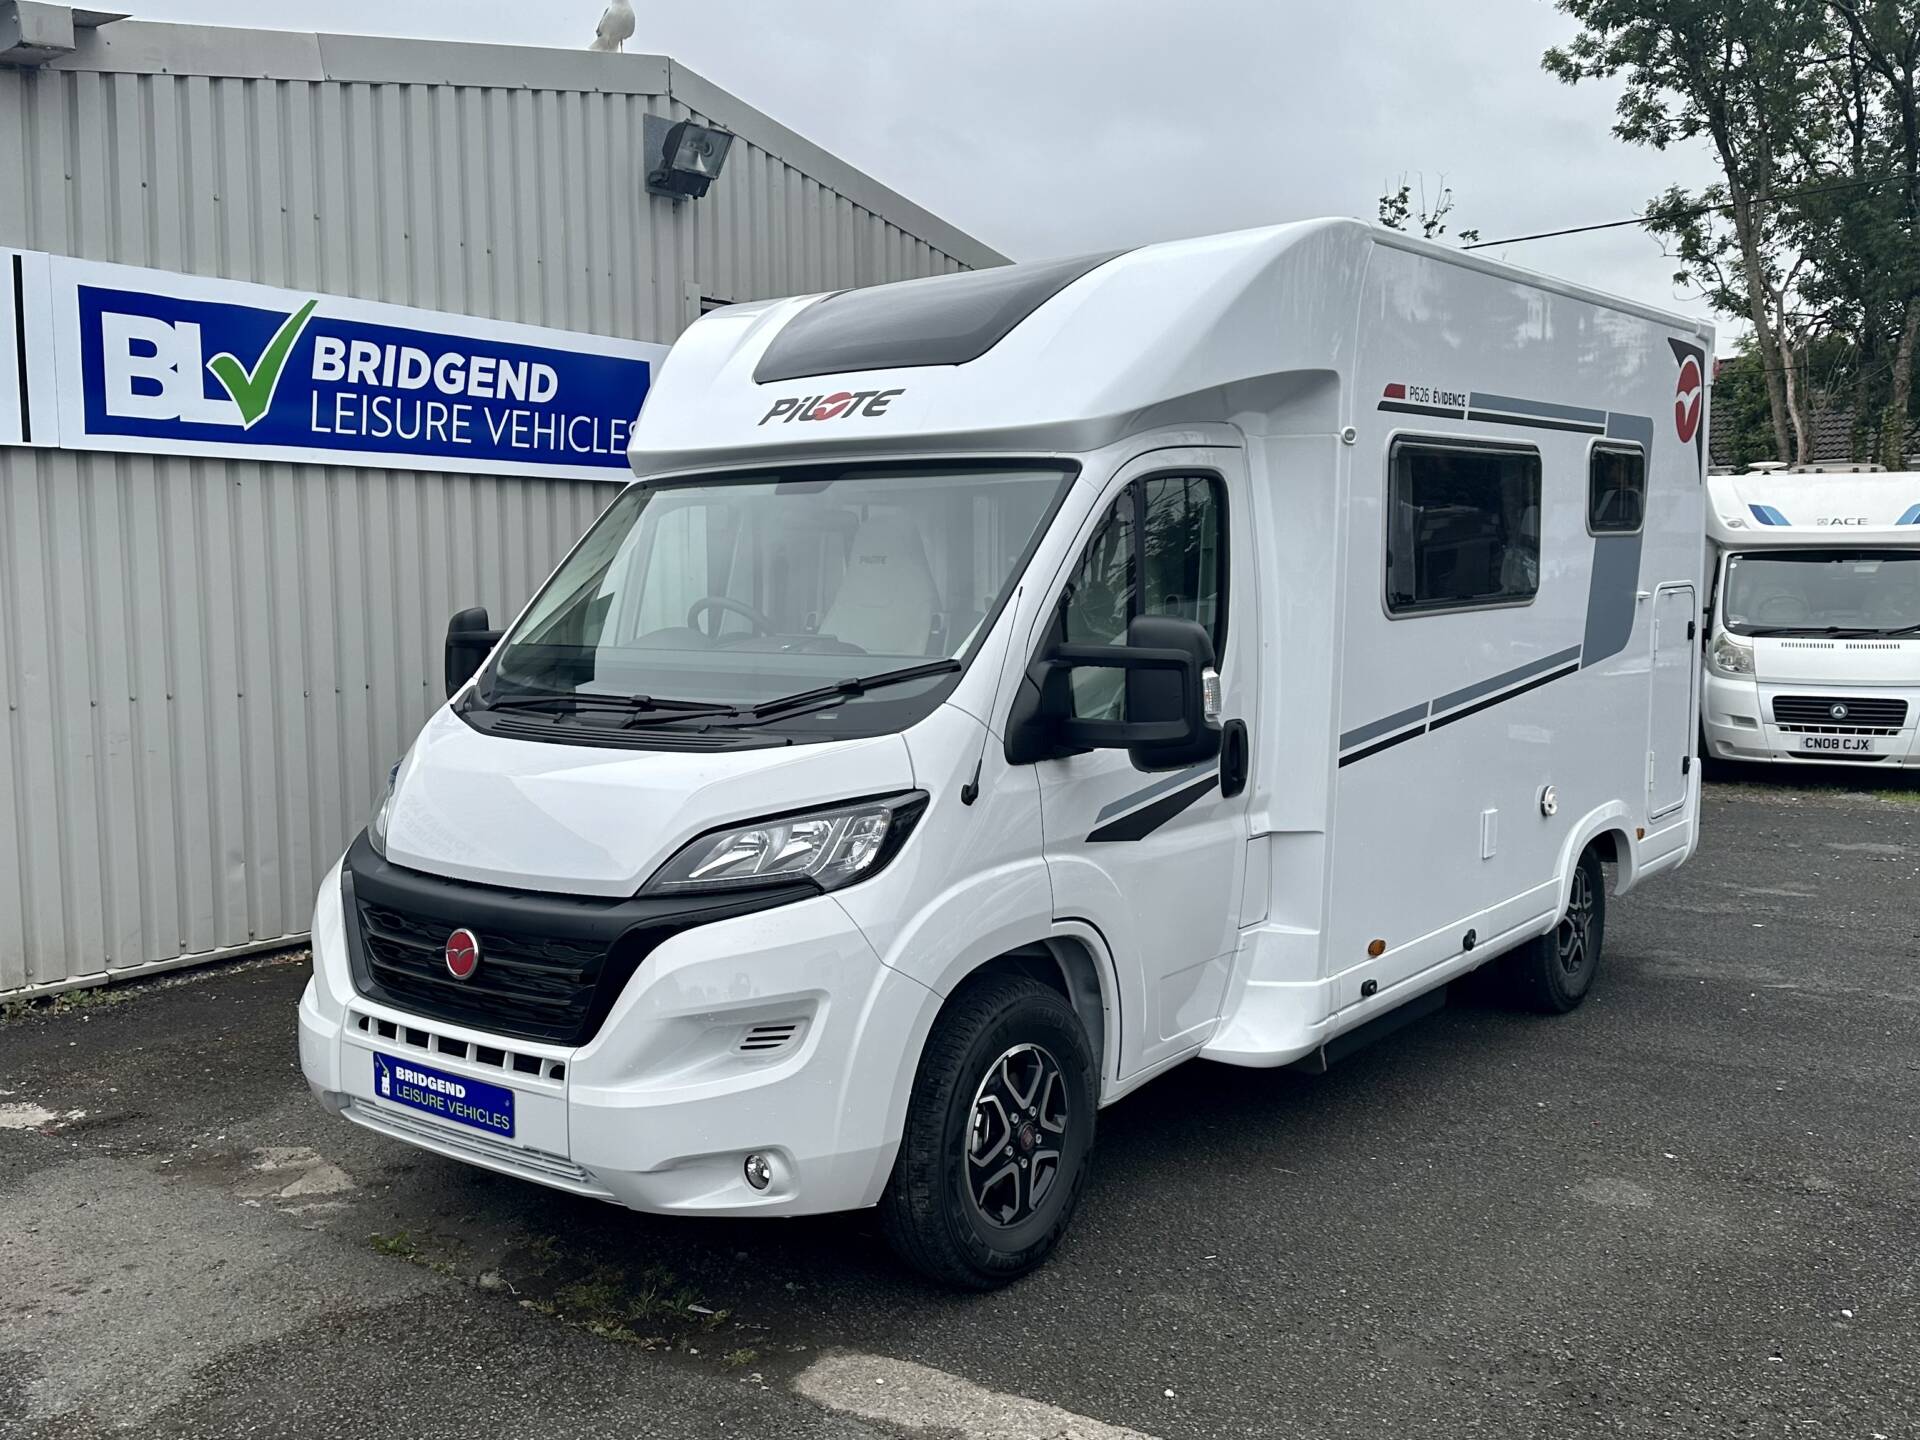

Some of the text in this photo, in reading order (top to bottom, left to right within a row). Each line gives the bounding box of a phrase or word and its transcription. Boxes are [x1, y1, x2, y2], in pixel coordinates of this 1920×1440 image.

[311, 335, 559, 404] BRIDGEND
[1409, 386, 1430, 403] P626
[311, 390, 473, 444] LEISURE
[1830, 517, 1869, 526] ACE
[1805, 737, 1869, 751] CN08 CJX
[395, 1066, 467, 1099] BRIDGEND
[396, 1083, 511, 1130] LEISURE VEHICLES
